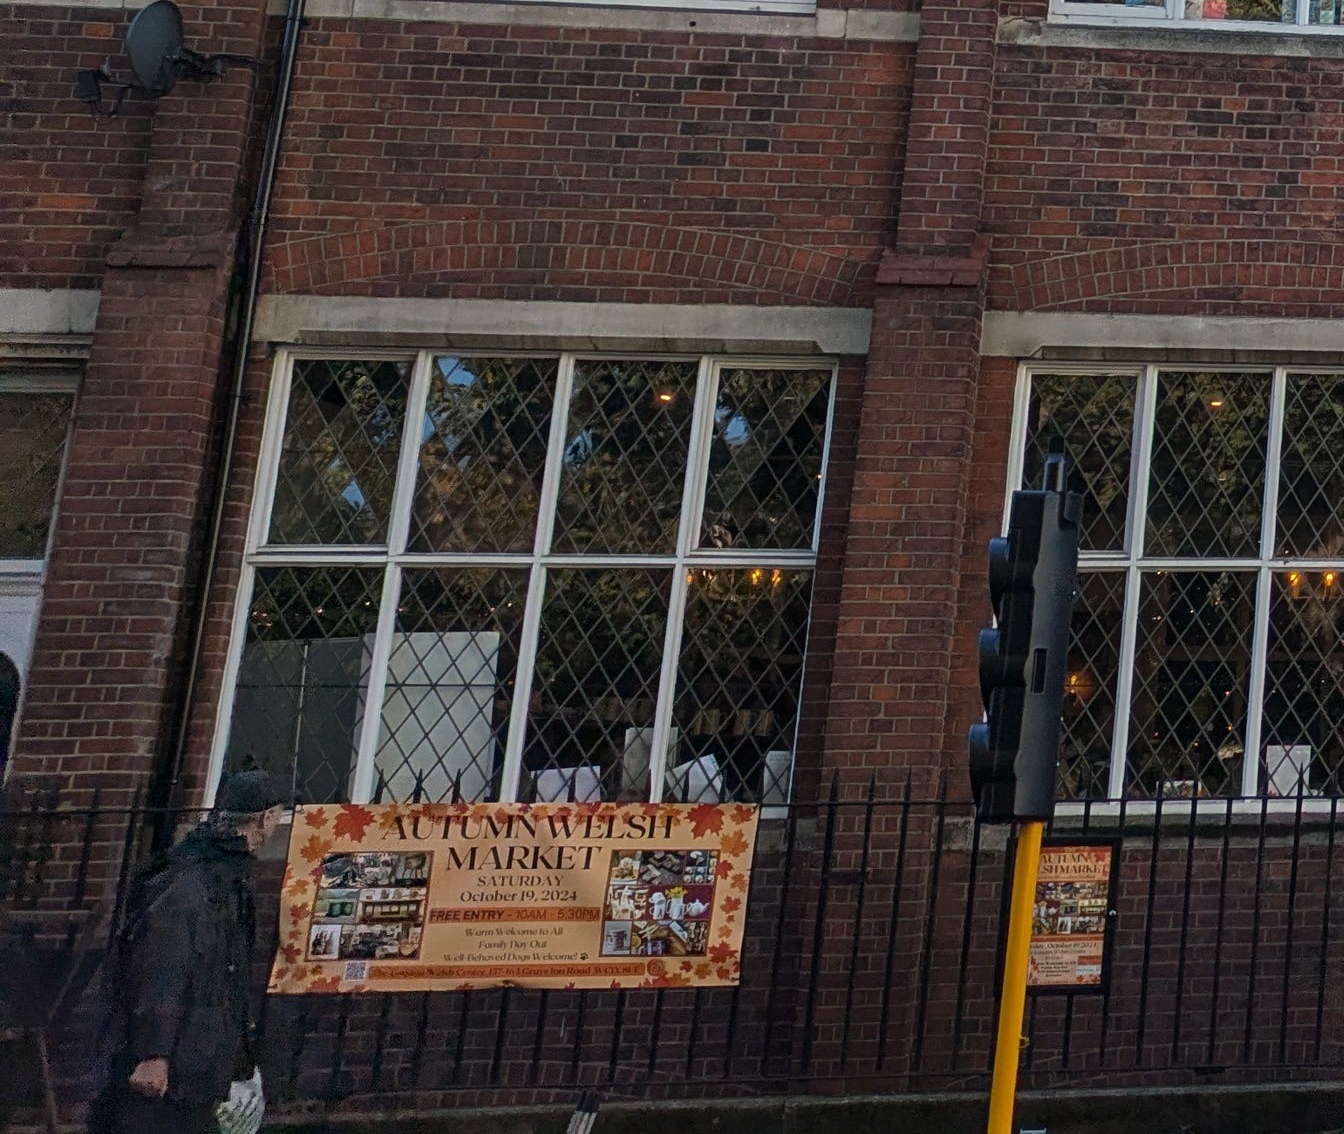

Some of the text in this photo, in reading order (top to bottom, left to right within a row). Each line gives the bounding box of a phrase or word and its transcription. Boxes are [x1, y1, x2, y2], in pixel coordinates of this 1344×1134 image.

[382, 815, 674, 840] AUTUMN WELSH
[445, 845, 602, 870] MARKET
[1041, 853, 1088, 864] AUTUMN
[477, 875, 563, 887] SATURDAY
[460, 890, 577, 902] October 19, 2024
[430, 909, 461, 922] FREE
[463, 909, 505, 921] ENTRY
[516, 908, 546, 920] 10AM
[557, 908, 600, 920] 5:30PM
[465, 928, 494, 936] Warm
[496, 927, 538, 936] Welcome
[478, 940, 547, 950] Family Day Out
[443, 952, 577, 962] Well-Behaved Dogs Welcome!
